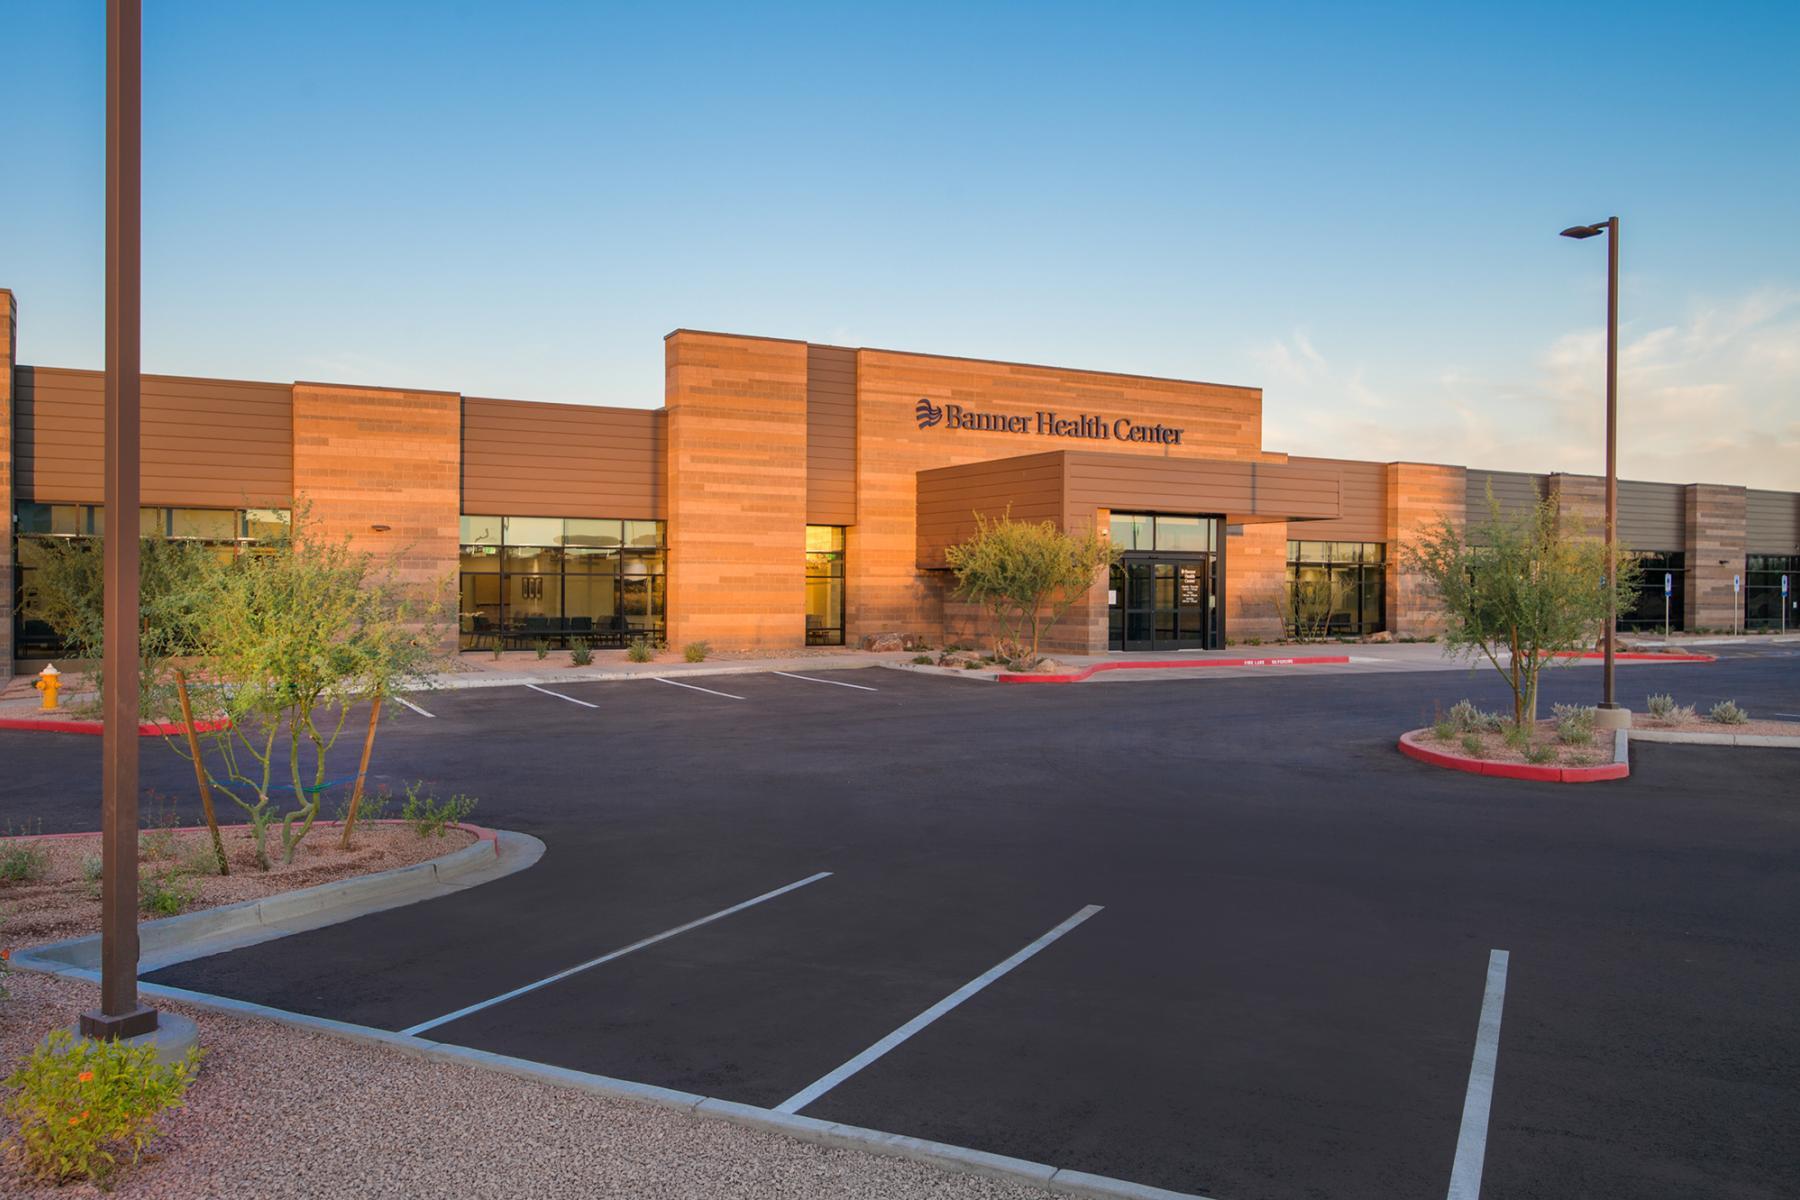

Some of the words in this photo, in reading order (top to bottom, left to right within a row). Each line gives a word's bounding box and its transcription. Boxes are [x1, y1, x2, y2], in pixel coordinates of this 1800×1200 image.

[945, 404, 1032, 434] Banner
[1036, 411, 1109, 440] Health
[1113, 418, 1184, 445] Center
